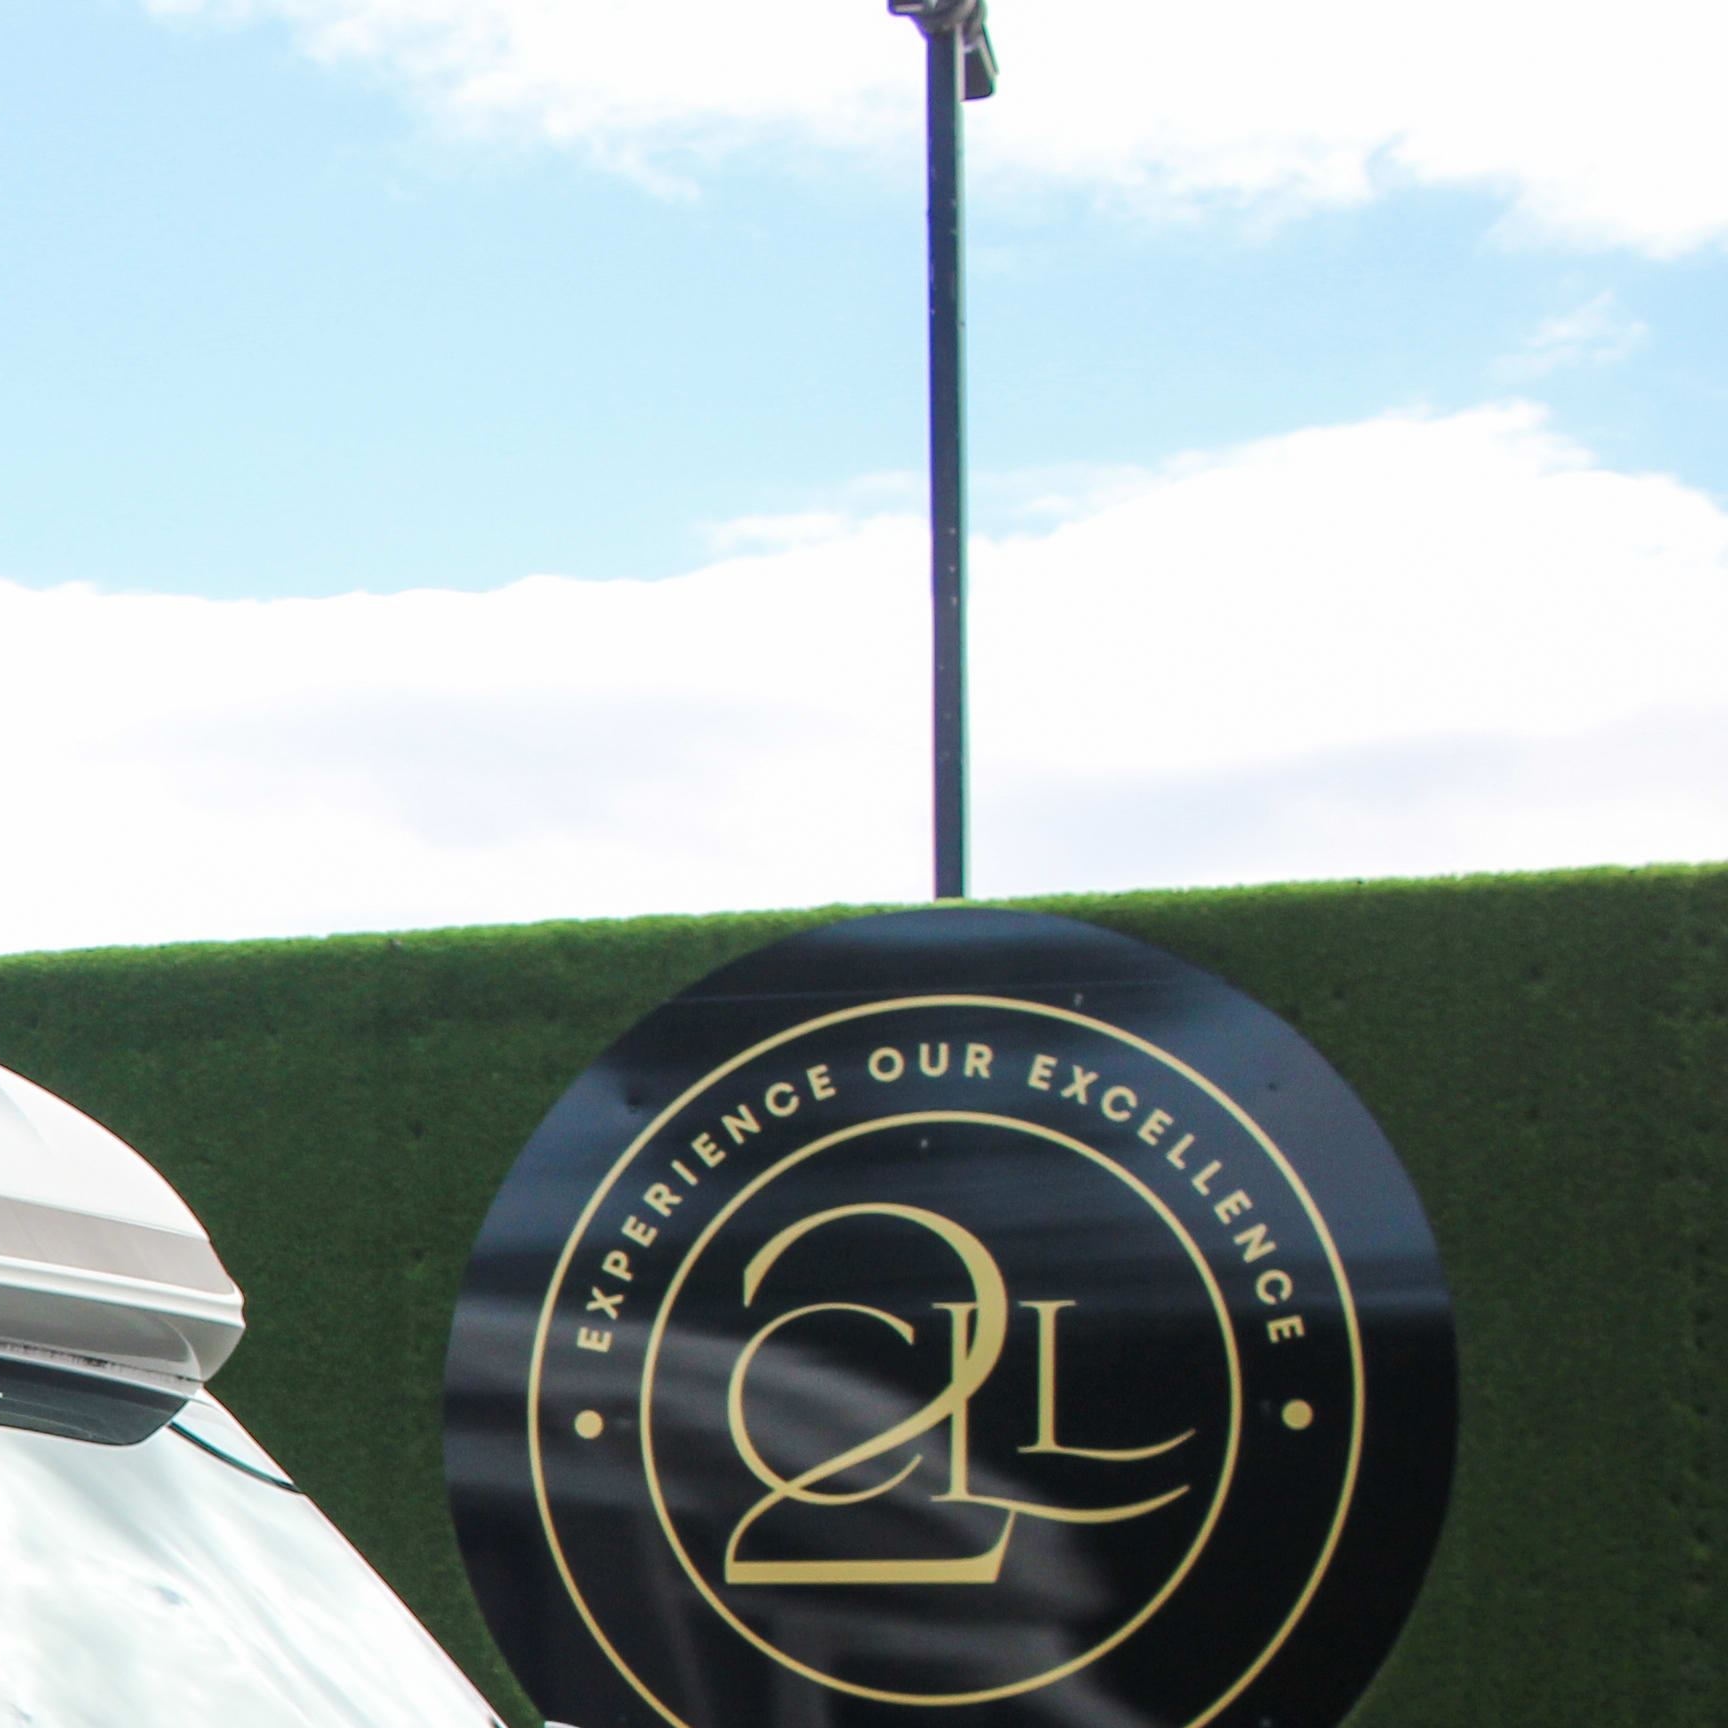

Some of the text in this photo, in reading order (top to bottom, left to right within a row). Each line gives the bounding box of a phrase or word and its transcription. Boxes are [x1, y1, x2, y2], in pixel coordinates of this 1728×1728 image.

[577, 1043, 1305, 1352] EXPERIENCE OUR EXCELLENCE
